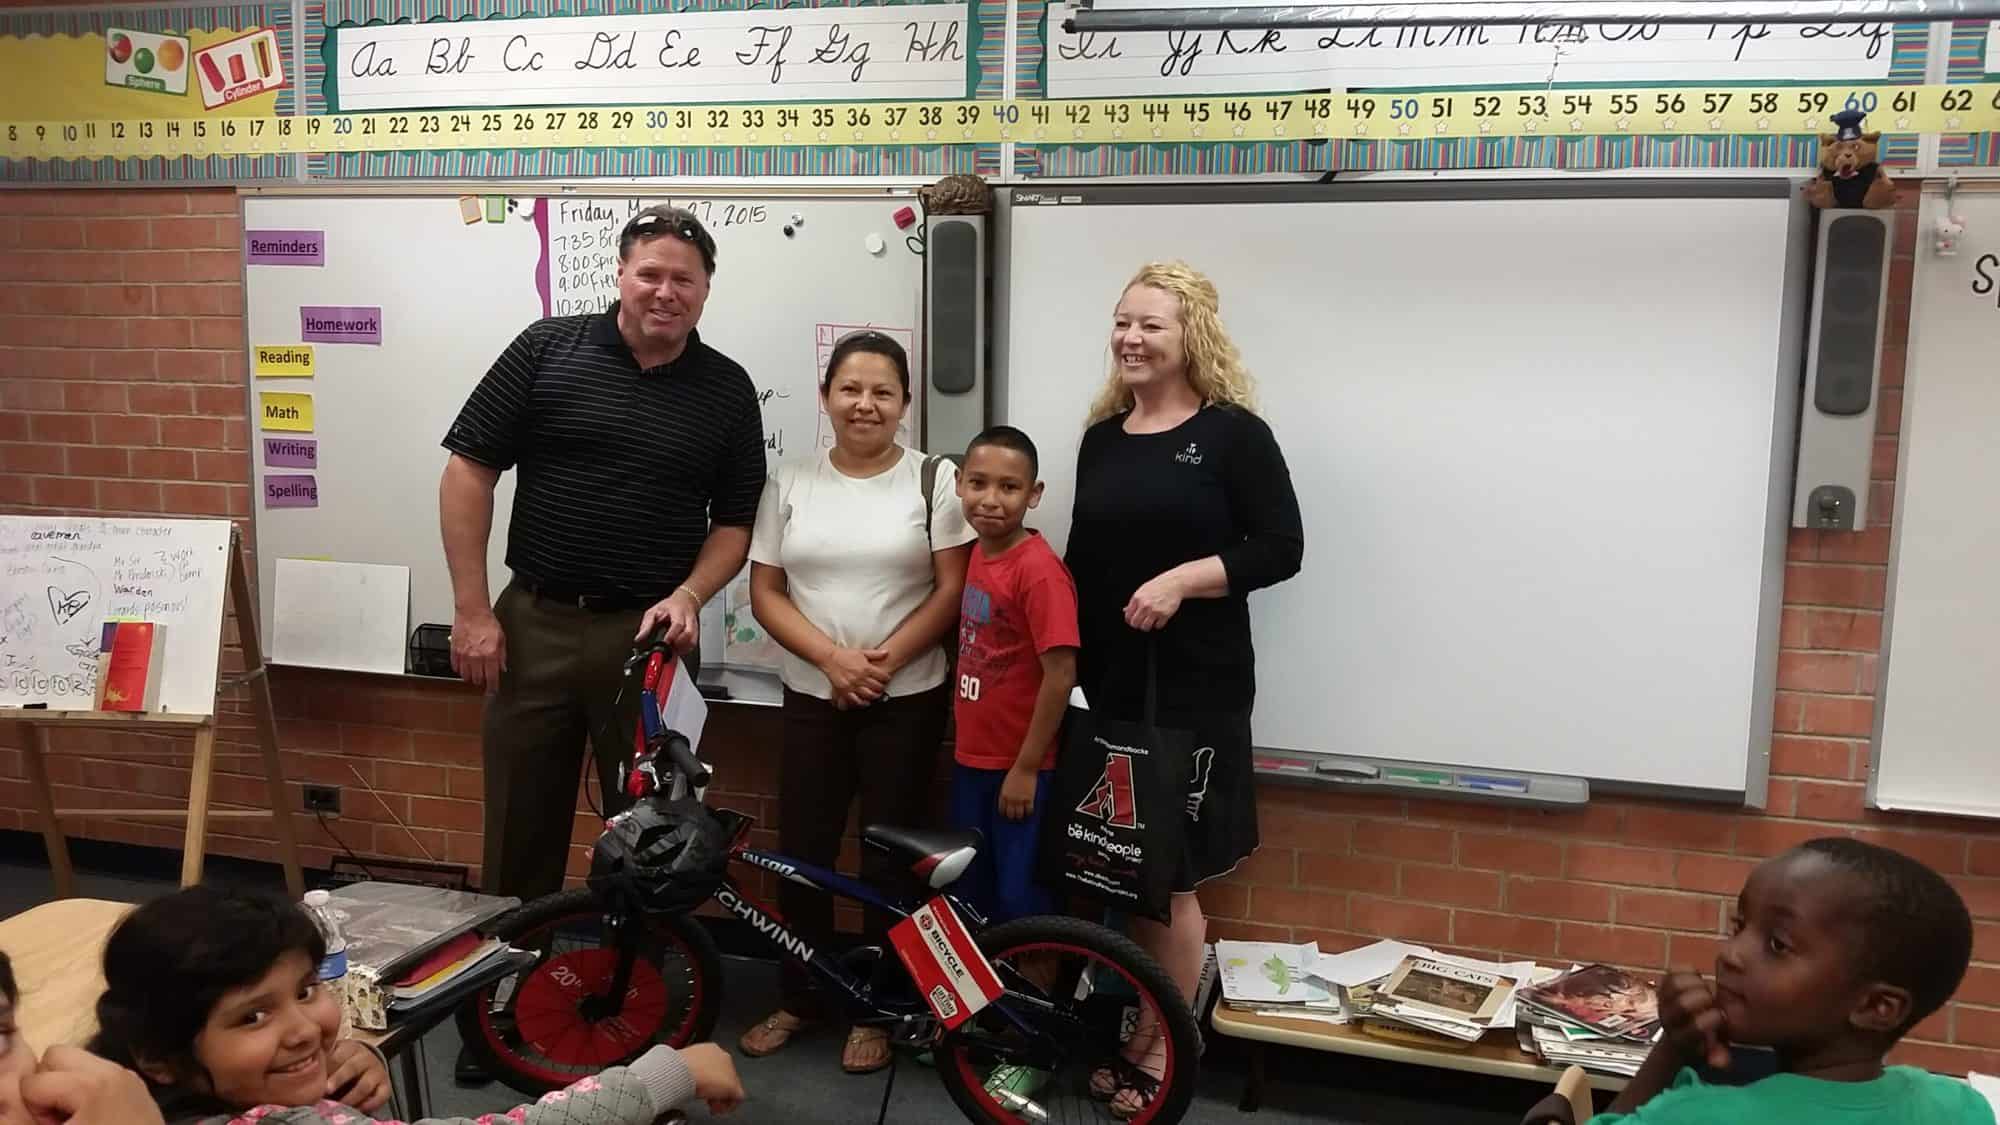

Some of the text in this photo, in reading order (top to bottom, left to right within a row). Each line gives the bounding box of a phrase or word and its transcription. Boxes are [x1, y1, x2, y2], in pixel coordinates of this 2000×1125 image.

[351, 21, 965, 84] Aa Bb Cc Dd Ee Ff Gg Hh
[225, 82, 261, 101] Cylinder
[8, 124, 17, 141] 8
[35, 125, 46, 140] 9
[63, 125, 78, 141] 10
[85, 122, 96, 138] 11
[111, 121, 126, 138] 12
[139, 121, 154, 138] 13
[166, 120, 181, 138] 14
[192, 120, 207, 137] 15
[220, 119, 237, 136] 16
[249, 119, 265, 136] 17
[277, 118, 293, 136] 18
[305, 117, 321, 135] 19
[332, 116, 353, 134] 20
[360, 116, 376, 135] 21
[388, 115, 409, 133] 22
[418, 115, 441, 133] 23
[449, 113, 472, 132] 24
[481, 113, 503, 131] 25
[512, 112, 535, 131] 26
[544, 111, 568, 130] 27
[576, 111, 600, 129] 28
[610, 110, 634, 129] 29
[645, 110, 669, 128] 30
[675, 109, 692, 128] 31
[706, 109, 730, 128] 32
[741, 108, 765, 128] 33
[776, 108, 800, 128] 34
[811, 107, 835, 127] 35
[846, 107, 872, 127] 36
[883, 106, 909, 126] 37
[917, 105, 943, 126] 38
[956, 104, 981, 125] 39
[992, 104, 1020, 124] 40
[1031, 103, 1050, 125] 41
[1064, 103, 1091, 124] 42
[1103, 103, 1130, 123] 43
[1142, 102, 1171, 123] 44
[1183, 101, 1211, 122] 45
[1223, 100, 1253, 121] 46
[1265, 99, 1295, 120] 47
[1303, 97, 1333, 119] 48
[1345, 97, 1377, 119] 49
[1388, 98, 1420, 119] 50
[1431, 96, 1454, 118] 51
[1472, 95, 1502, 117] 52
[1516, 95, 1547, 116] 53
[1561, 94, 1593, 115] 54
[1608, 93, 1639, 114] 55
[1654, 92, 1686, 114] 56
[1701, 92, 1734, 114] 57
[1748, 92, 1780, 114] 58
[1796, 91, 1830, 113] 59
[1844, 92, 1878, 113] 60
[1891, 90, 1917, 112] 61
[1939, 88, 1974, 112] 62
[560, 199, 619, 231] Friday,
[724, 204, 767, 227] 2015
[250, 239, 319, 255] Reminders
[1971, 253, 2000, 308] S
[305, 316, 378, 332] Homework
[260, 350, 311, 367] Reading
[265, 405, 300, 420] Math
[268, 442, 315, 460] Writing
[1175, 451, 1203, 465] kind
[268, 483, 318, 501] Spelling
[960, 674, 981, 701] 90
[1067, 823, 1084, 839] be
[1083, 828, 1108, 847] kind
[1106, 843, 1142, 858] eople
[712, 888, 815, 962] CHWINN
[931, 929, 965, 979] BICYCLE
[1421, 962, 1493, 984] BIG CATS
